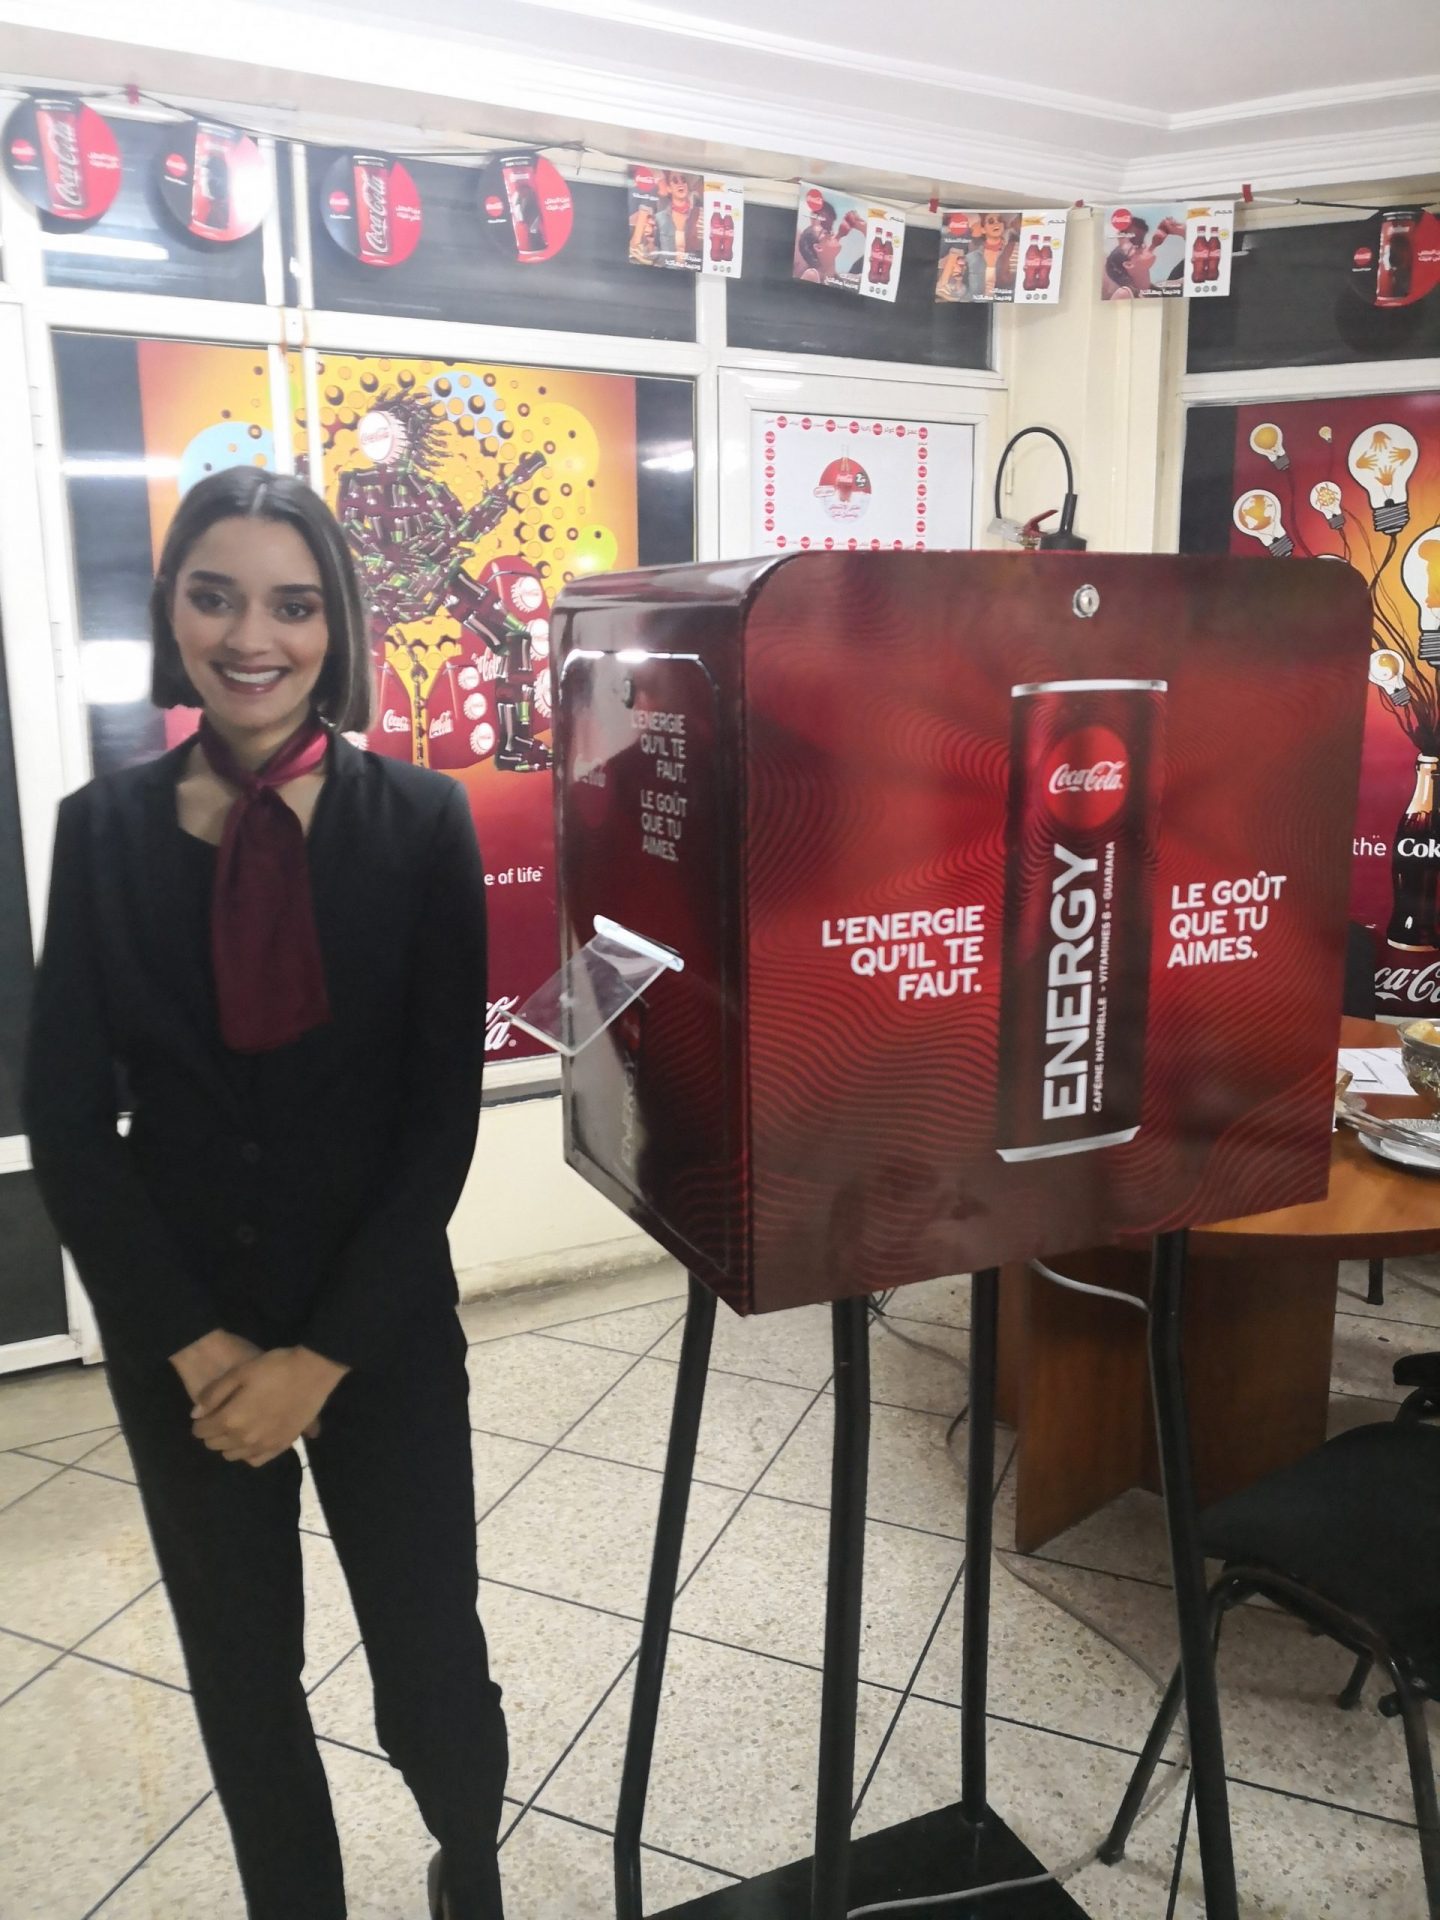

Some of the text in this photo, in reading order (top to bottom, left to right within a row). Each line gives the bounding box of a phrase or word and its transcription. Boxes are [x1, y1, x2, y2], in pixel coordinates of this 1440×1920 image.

[670, 737, 687, 760] TE
[1048, 760, 1127, 795] Coca-Cola
[640, 789, 654, 811] LE
[640, 812, 682, 841] QUE TU
[498, 869, 514, 885] of
[1103, 841, 1116, 901] GUARANA
[1172, 870, 1287, 910] LE GOÛT
[821, 904, 985, 948] L'ENERGIE
[1169, 905, 1269, 940] QUE TU
[850, 935, 984, 977] QU'IL TE
[1099, 921, 1112, 983] VITAMINES
[1166, 935, 1259, 969] AIMES.
[898, 966, 983, 1002] FAUT.
[1043, 843, 1099, 1120] ENERGY
[1095, 997, 1108, 1062] NATURELLE
